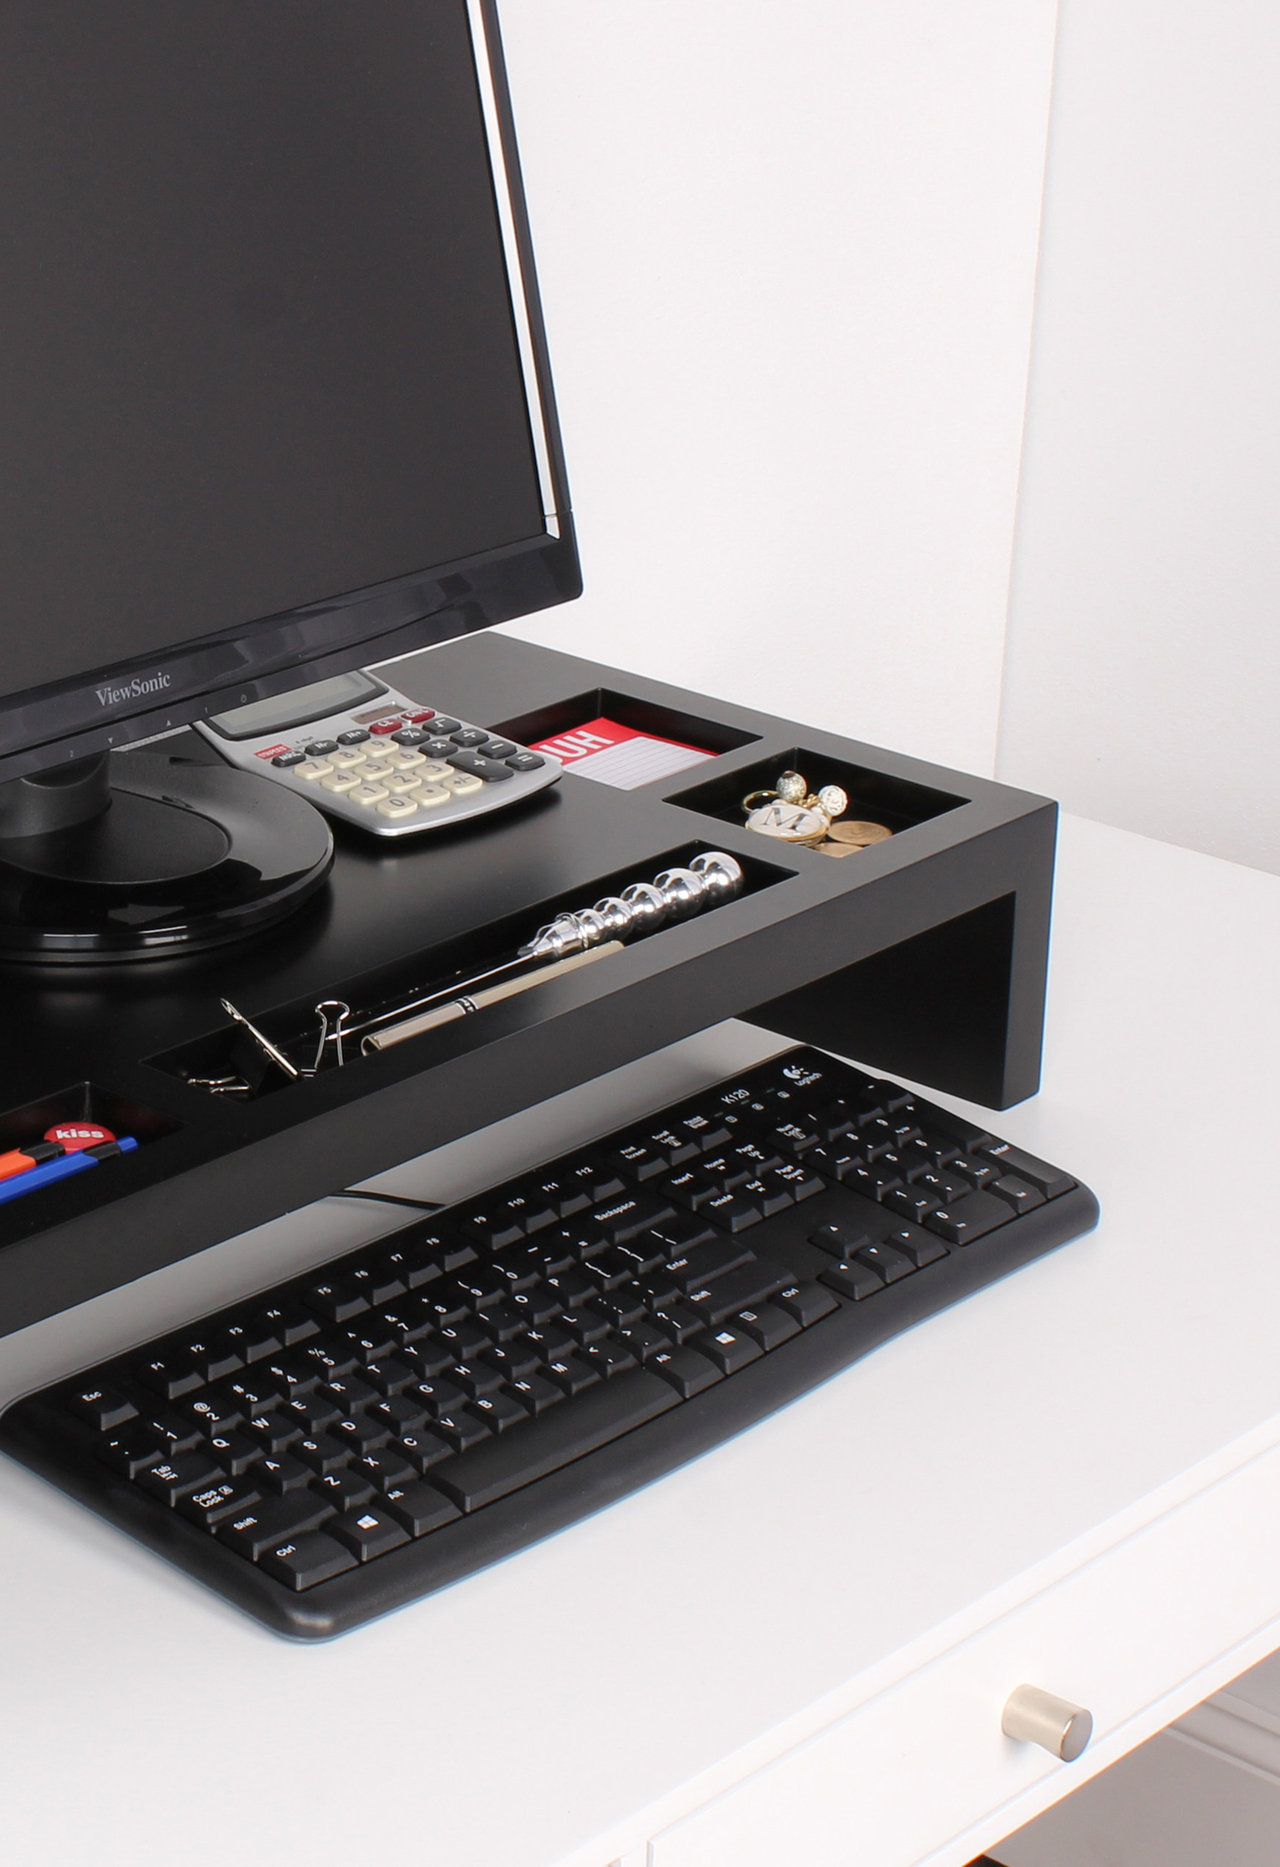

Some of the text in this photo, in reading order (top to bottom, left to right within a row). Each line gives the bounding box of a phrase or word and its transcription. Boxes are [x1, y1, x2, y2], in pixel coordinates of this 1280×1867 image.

[96, 671, 172, 707] ViewSonic
[371, 740, 385, 748] 9
[340, 751, 355, 759] 8
[305, 761, 319, 769] 7
[369, 763, 382, 771] 5
[427, 764, 442, 773] 3
[336, 774, 350, 782] 4
[397, 775, 412, 783] 2
[363, 786, 377, 794] 1
[389, 799, 405, 807] 0
[721, 1089, 751, 1106] K120
[55, 1128, 105, 1140] kiss
[594, 1202, 636, 1220] Backspace
[666, 1259, 688, 1270] Enter
[690, 1291, 711, 1301] Shift
[782, 1288, 799, 1297] Ctrl
[442, 1329, 456, 1337] U
[528, 1331, 543, 1340] K
[360, 1339, 374, 1349] 6
[405, 1346, 418, 1355] Y
[495, 1349, 505, 1357] J
[322, 1357, 336, 1366] 5
[368, 1365, 380, 1373] T
[455, 1366, 470, 1375] H
[551, 1363, 567, 1373] M
[330, 1383, 345, 1391] R
[419, 1385, 433, 1393] G
[515, 1382, 531, 1391] N
[82, 1392, 101, 1401] Esc
[291, 1401, 306, 1410] E
[380, 1403, 390, 1412] F
[478, 1400, 492, 1409] B
[206, 1411, 220, 1421] 2
[251, 1418, 269, 1428] W
[341, 1422, 356, 1430] D
[440, 1418, 454, 1427] V
[212, 1439, 230, 1448] Q
[303, 1441, 317, 1449] S
[404, 1438, 417, 1446] C
[266, 1461, 280, 1470] A
[363, 1457, 379, 1467] X
[324, 1476, 340, 1486] Z
[192, 1489, 218, 1503] Caps
[200, 1494, 225, 1508] Lock
[234, 1517, 257, 1530] Shift
[276, 1545, 296, 1556] Ctrl
